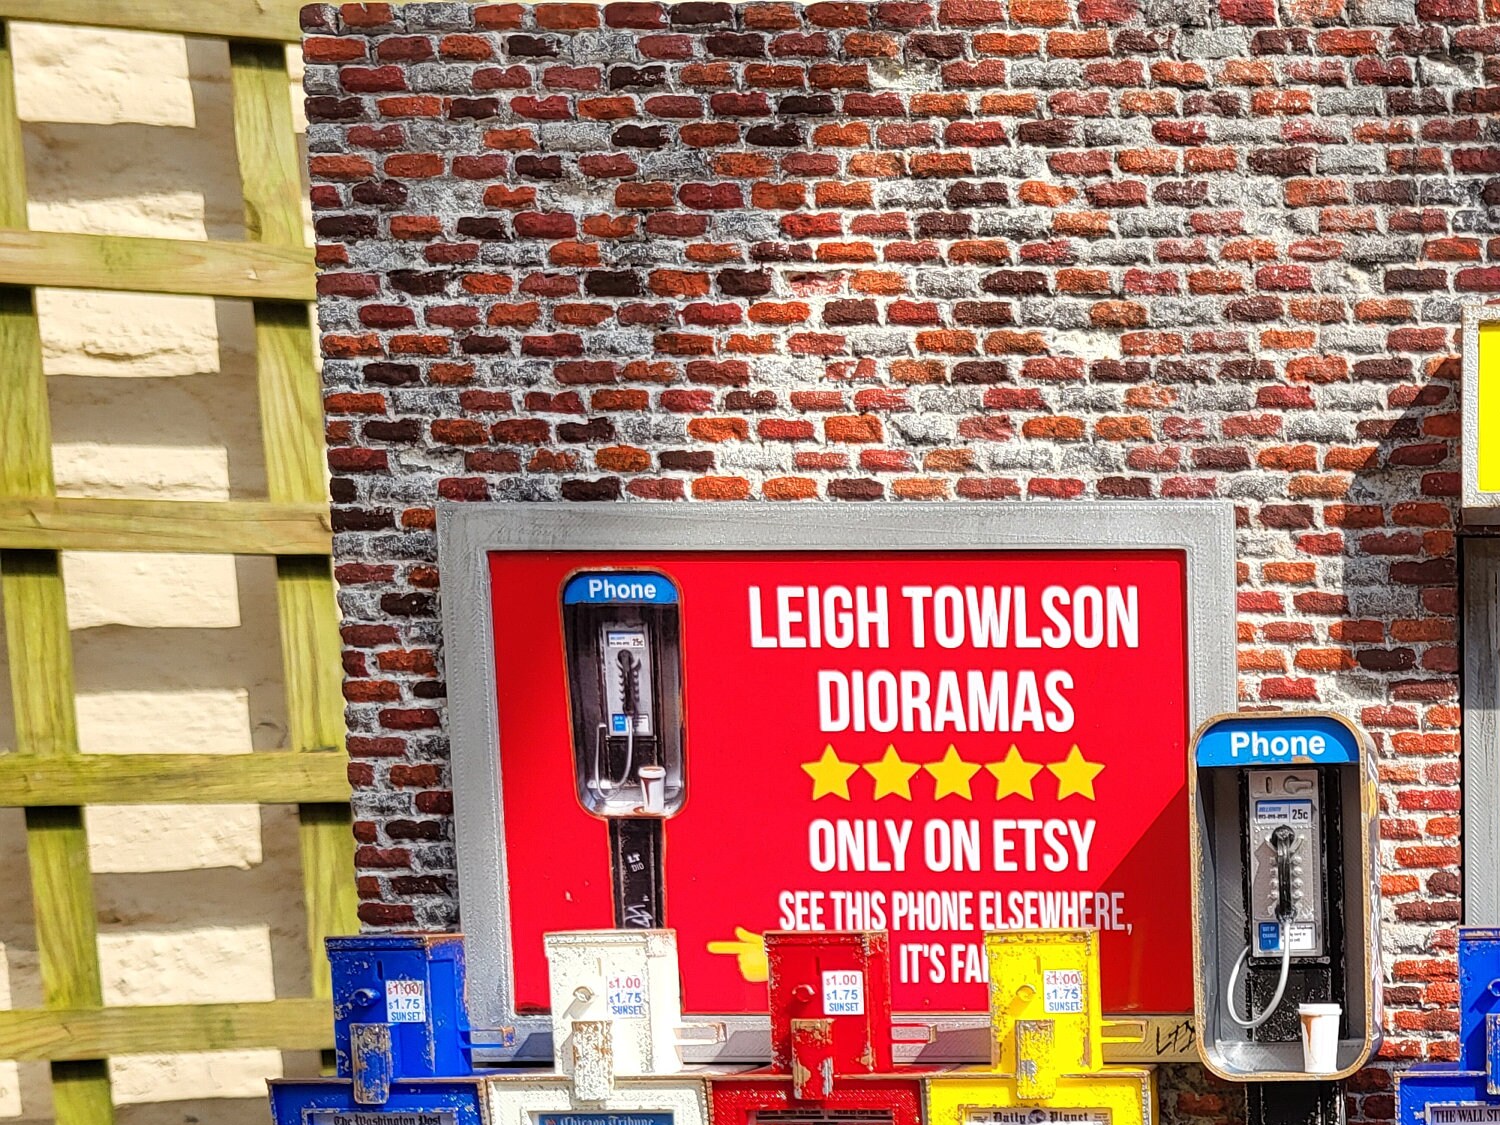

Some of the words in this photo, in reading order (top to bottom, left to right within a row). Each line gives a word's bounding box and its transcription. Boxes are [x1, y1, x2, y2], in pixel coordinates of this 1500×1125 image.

[588, 579, 657, 600] Phone
[748, 585, 892, 649] LEIGH
[901, 584, 1140, 649] TOWLSON
[818, 669, 1076, 733] DIORAMAS
[1229, 731, 1326, 758] Phone
[808, 818, 914, 873] ONLY
[924, 818, 984, 873] ON
[992, 818, 1097, 873] ETSY
[778, 890, 823, 934] SEE
[832, 890, 887, 933] THIS
[892, 890, 978, 933] PHONE
[980, 890, 1134, 936] ELSEWHERE,
[899, 943, 947, 984] IT'S
[608, 976, 642, 990] $1.00
[825, 973, 858, 988] $1.00
[1045, 971, 1080, 986] $1.00
[388, 982, 423, 996] $1.00
[825, 989, 859, 1001] $1.75
[1045, 987, 1081, 1000] $1.75
[388, 997, 421, 1010] $1.75
[608, 991, 643, 1004] $1.75
[611, 1005, 643, 1016] SUNSET
[828, 1002, 862, 1013] SUNSET
[1048, 1001, 1079, 1013] SUNSET
[390, 1011, 422, 1022] SUNSET
[992, 1111, 1026, 1124] Daily
[1049, 1111, 1088, 1123] Planet
[1433, 1109, 1456, 1123] THE
[1457, 1109, 1486, 1123] WALL
